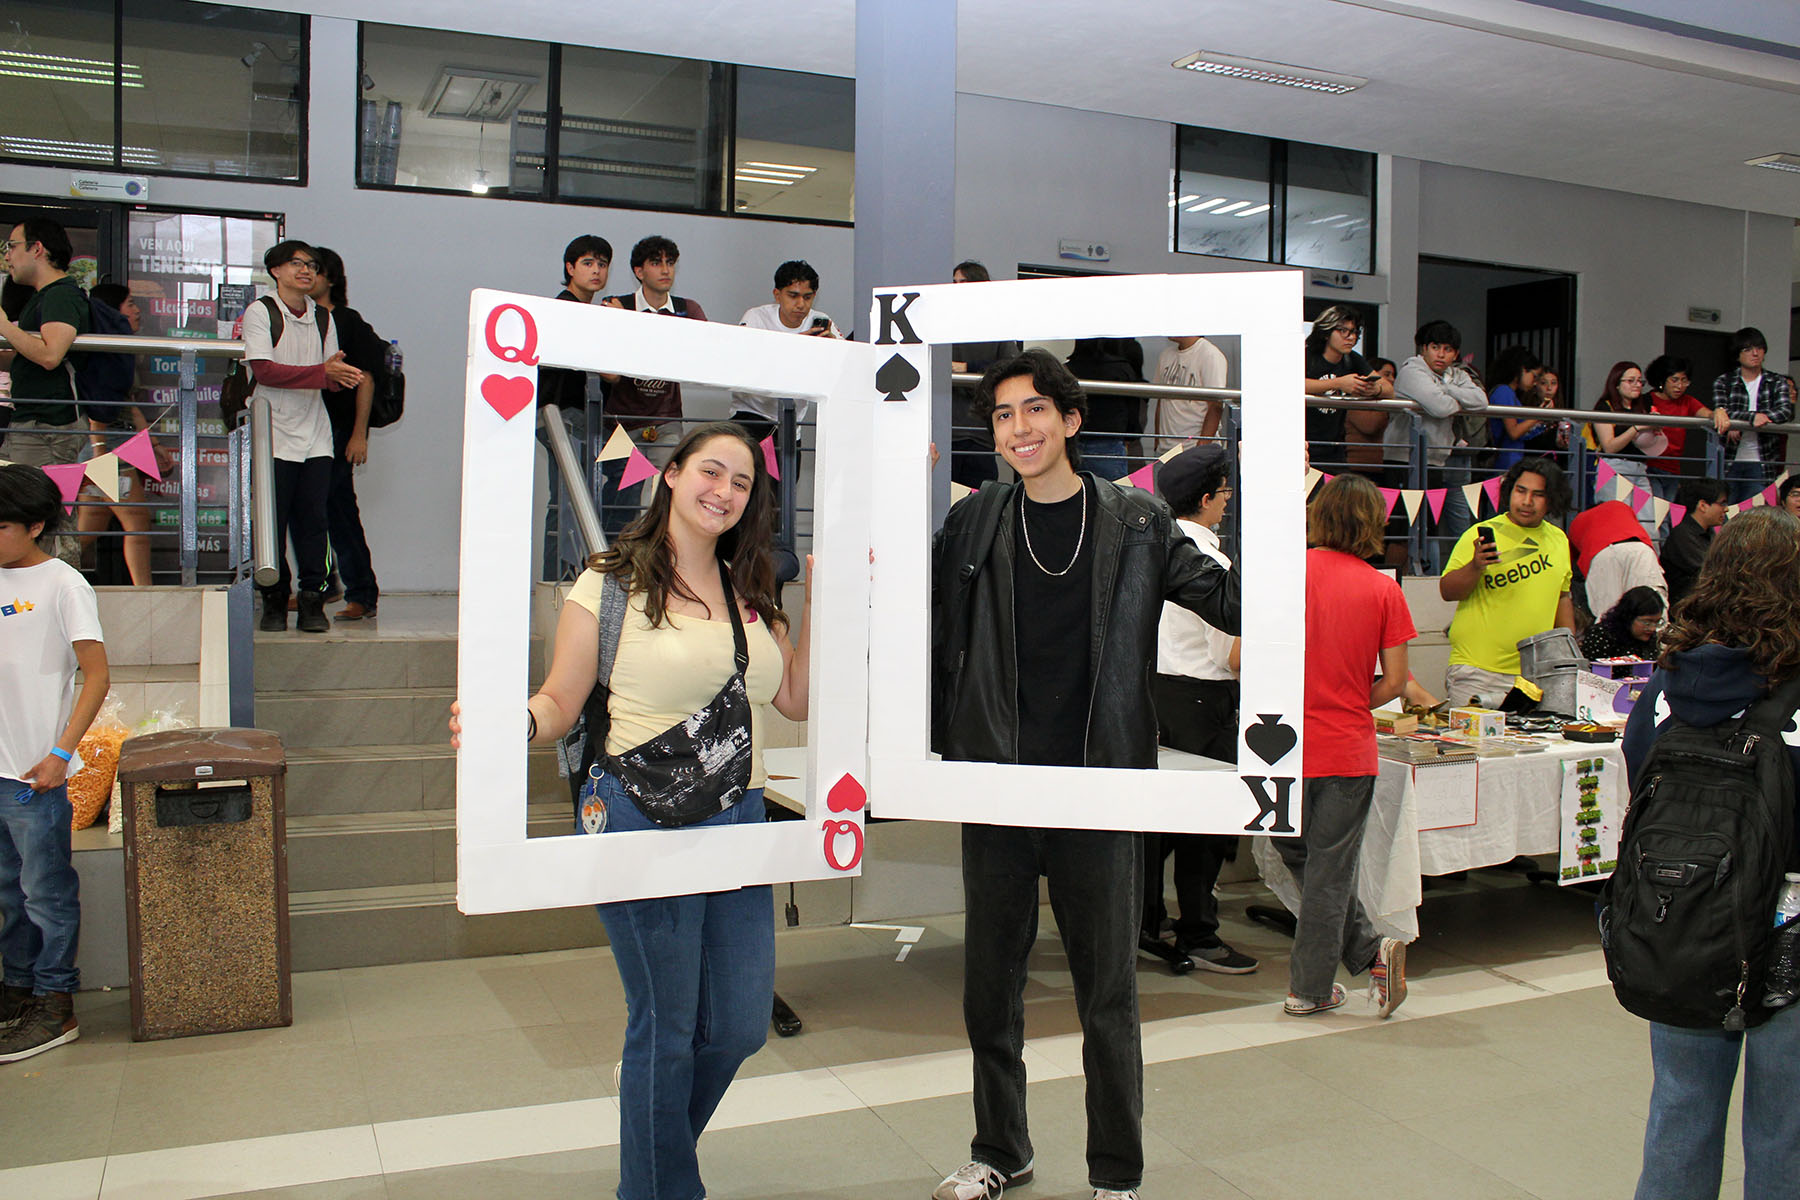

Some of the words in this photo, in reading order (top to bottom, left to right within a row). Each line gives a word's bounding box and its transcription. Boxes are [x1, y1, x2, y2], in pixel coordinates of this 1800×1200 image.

[139, 238, 163, 250] VEN
[485, 303, 540, 366] Q
[875, 292, 923, 345] K
[1484, 553, 1553, 589] Reebok
[1240, 775, 1296, 833] K
[822, 819, 864, 871] Q
